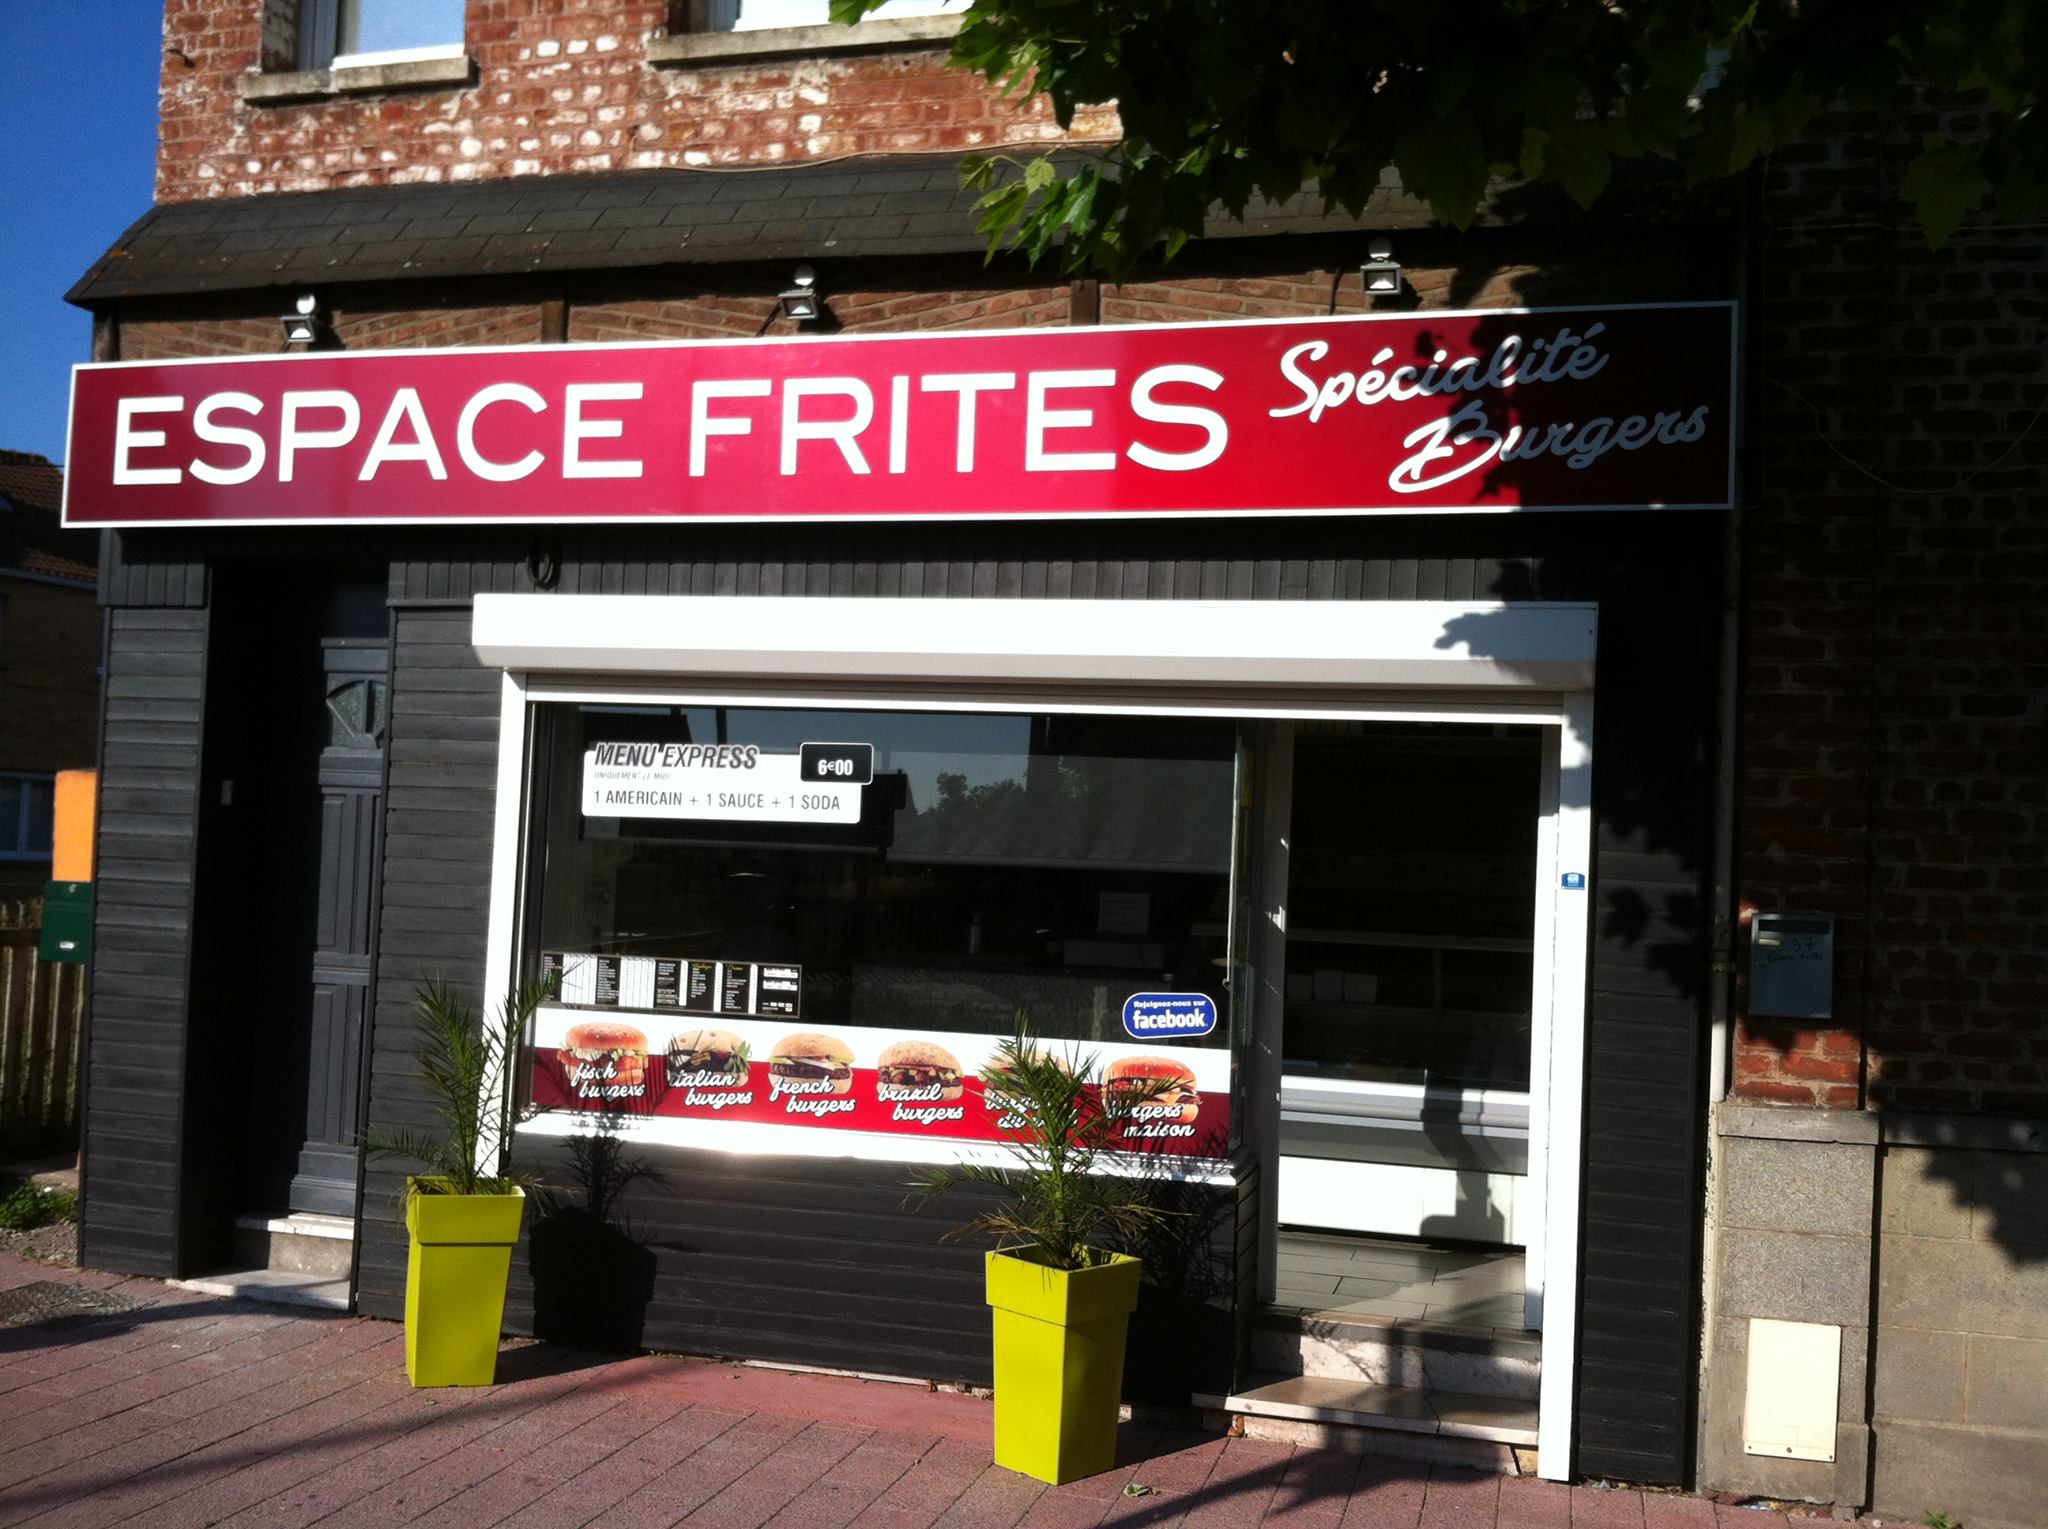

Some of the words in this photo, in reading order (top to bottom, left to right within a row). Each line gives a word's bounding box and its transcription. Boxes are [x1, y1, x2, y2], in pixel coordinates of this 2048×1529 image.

[1268, 322, 1610, 423] Spécialité
[112, 382, 644, 486] ESPACE
[688, 364, 1229, 477] FRITES
[1388, 400, 1710, 493] Burgers
[594, 743, 657, 767] MENU
[661, 745, 758, 770] EXPRESS
[817, 758, 854, 776] 6€00
[594, 790, 600, 804] 1
[605, 790, 683, 806] AMERICAIN
[706, 793, 713, 807] 1
[718, 793, 765, 808] SAUCE
[789, 794, 796, 809] 1
[801, 795, 841, 810] SODA
[1133, 1008, 1206, 1029] facebook
[669, 1069, 737, 1088] italian
[769, 1074, 836, 1102] french
[579, 1080, 646, 1102] burgers
[684, 1086, 753, 1110] burgers
[877, 1083, 944, 1103] brazil
[785, 1092, 856, 1118] burgers
[891, 1102, 965, 1126] burgers
[1107, 1100, 1183, 1123] rgers
[1123, 1121, 1196, 1138] maison
